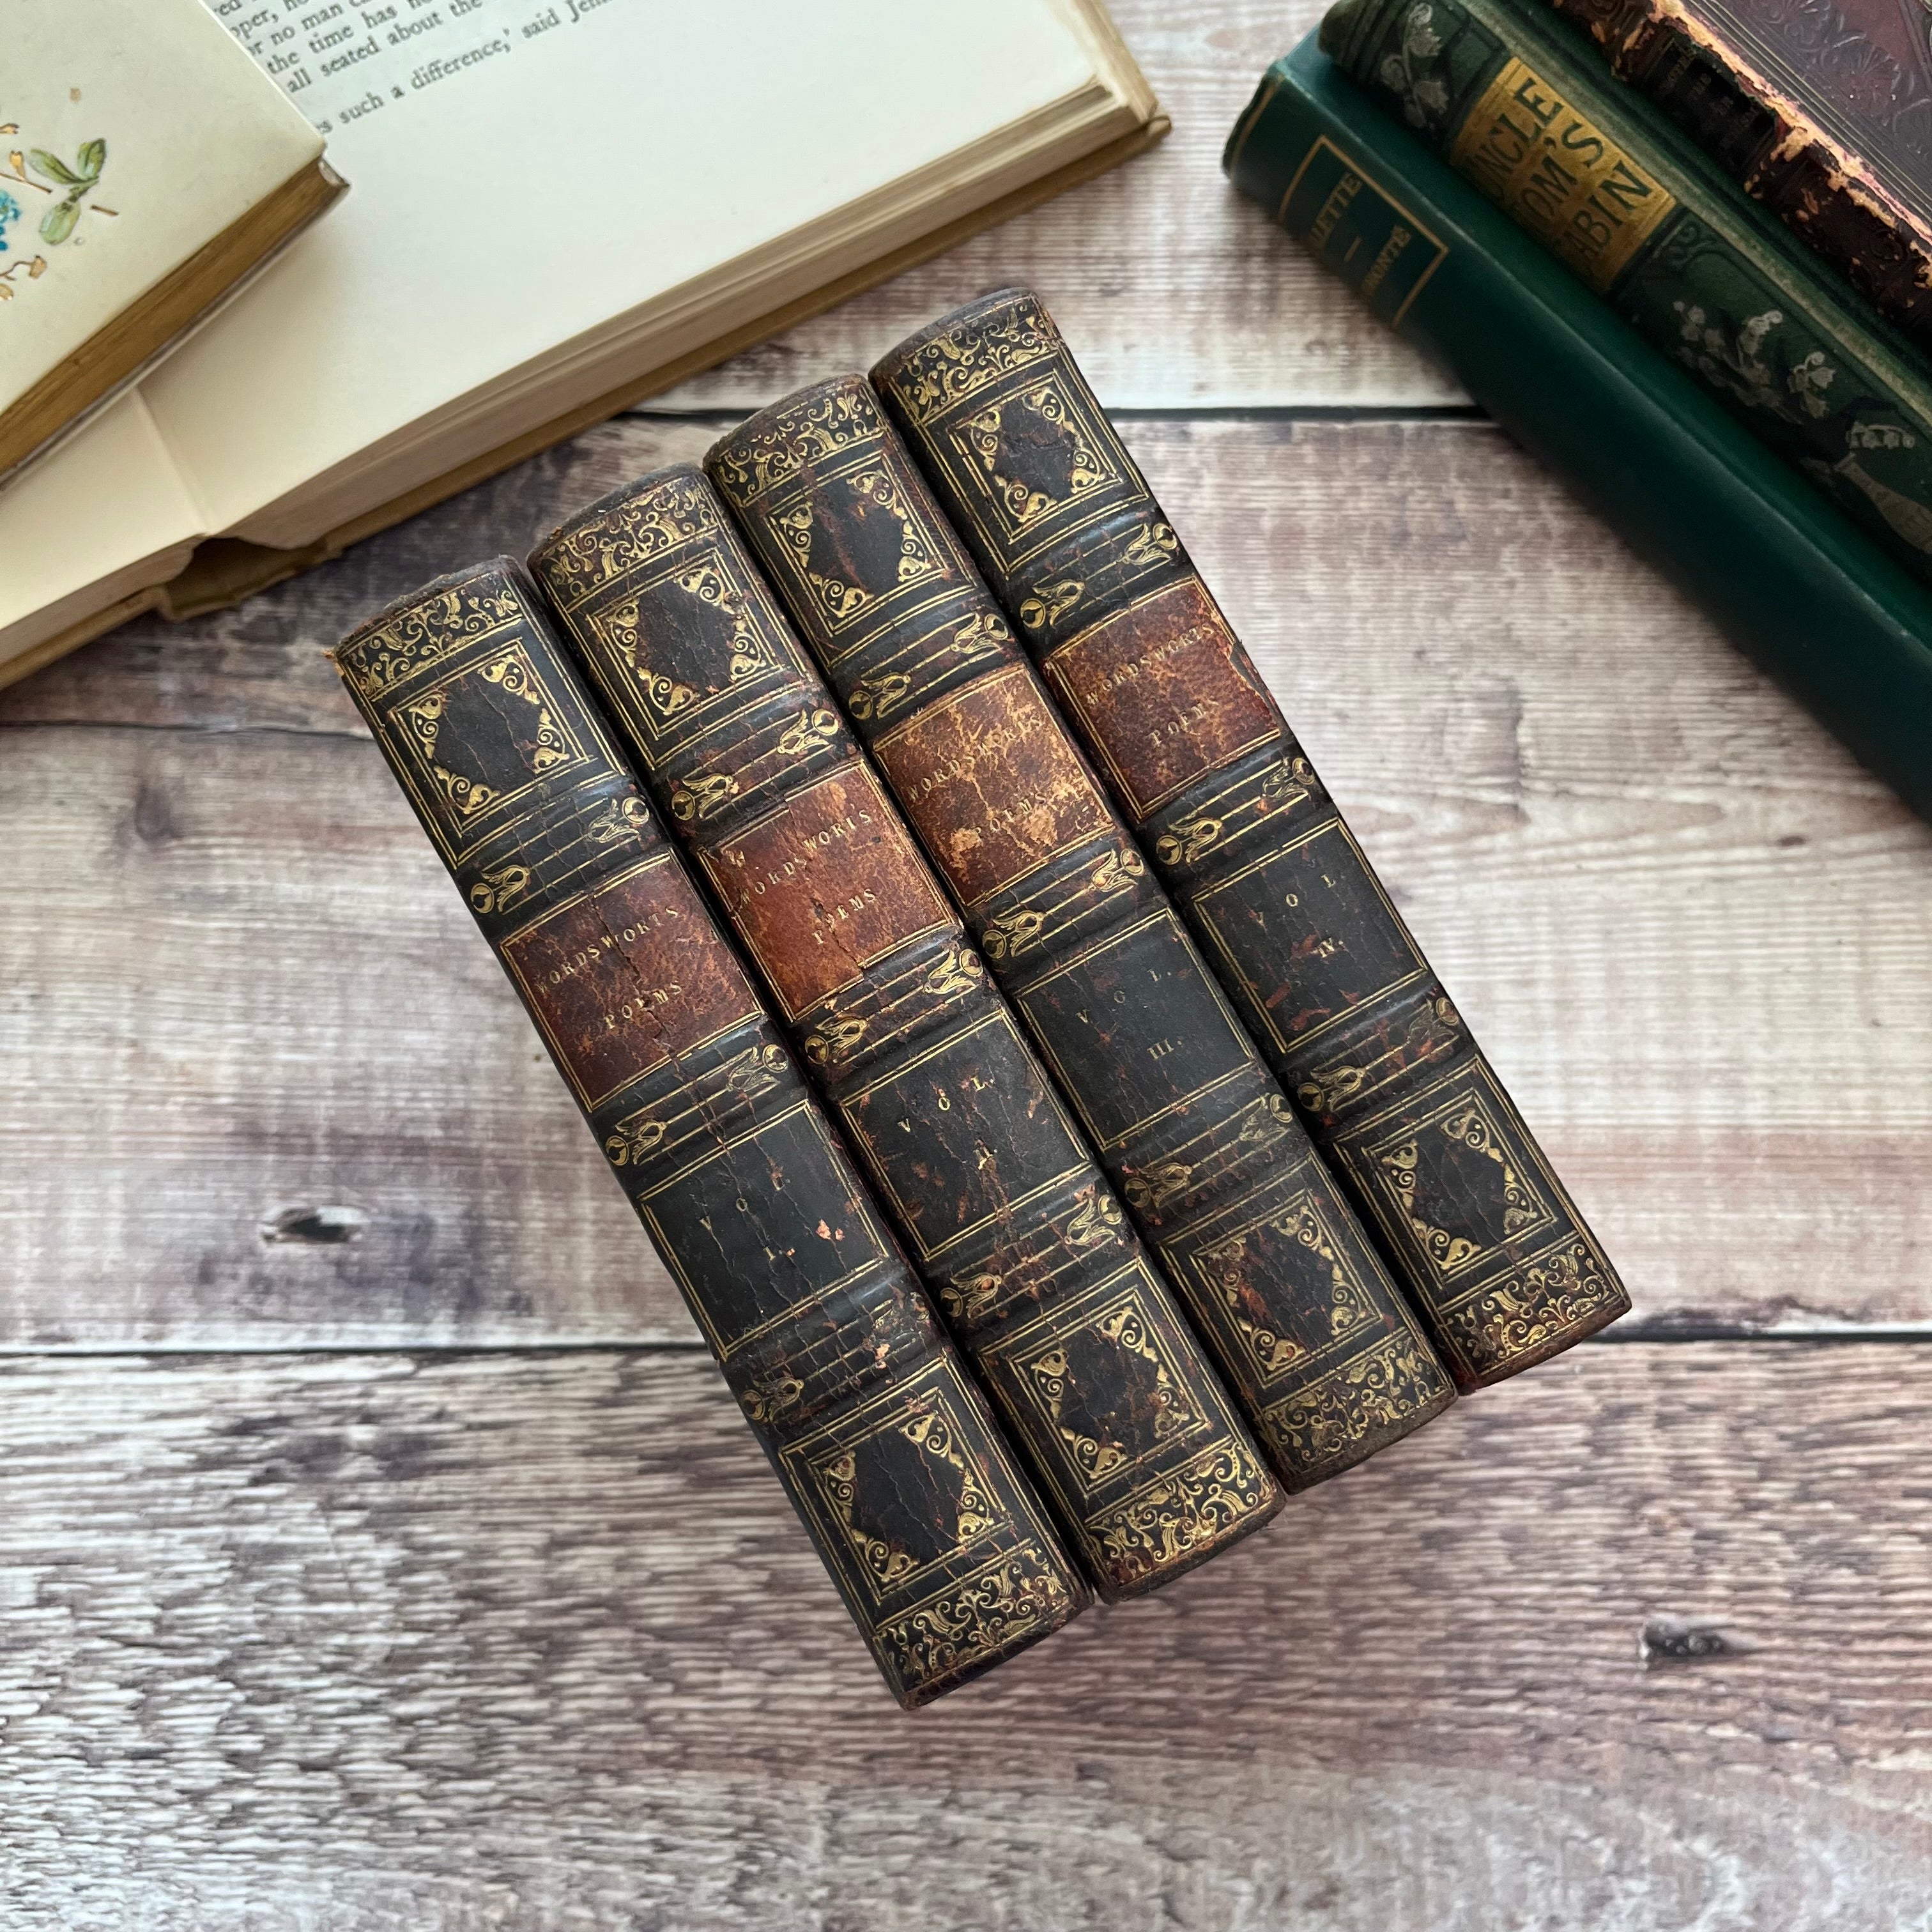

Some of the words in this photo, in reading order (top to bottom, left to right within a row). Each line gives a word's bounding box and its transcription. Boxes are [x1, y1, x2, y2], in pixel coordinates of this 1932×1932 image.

[267, 51, 301, 74] the
[309, 26, 355, 54] time
[362, 5, 397, 29] has
[271, 26, 296, 45] no
[301, 3, 344, 31] man
[287, 66, 312, 93] all
[320, 35, 381, 76] seated
[387, 12, 444, 46] about
[339, 91, 384, 124] such
[390, 86, 405, 100] a
[521, 7, 561, 39] said
